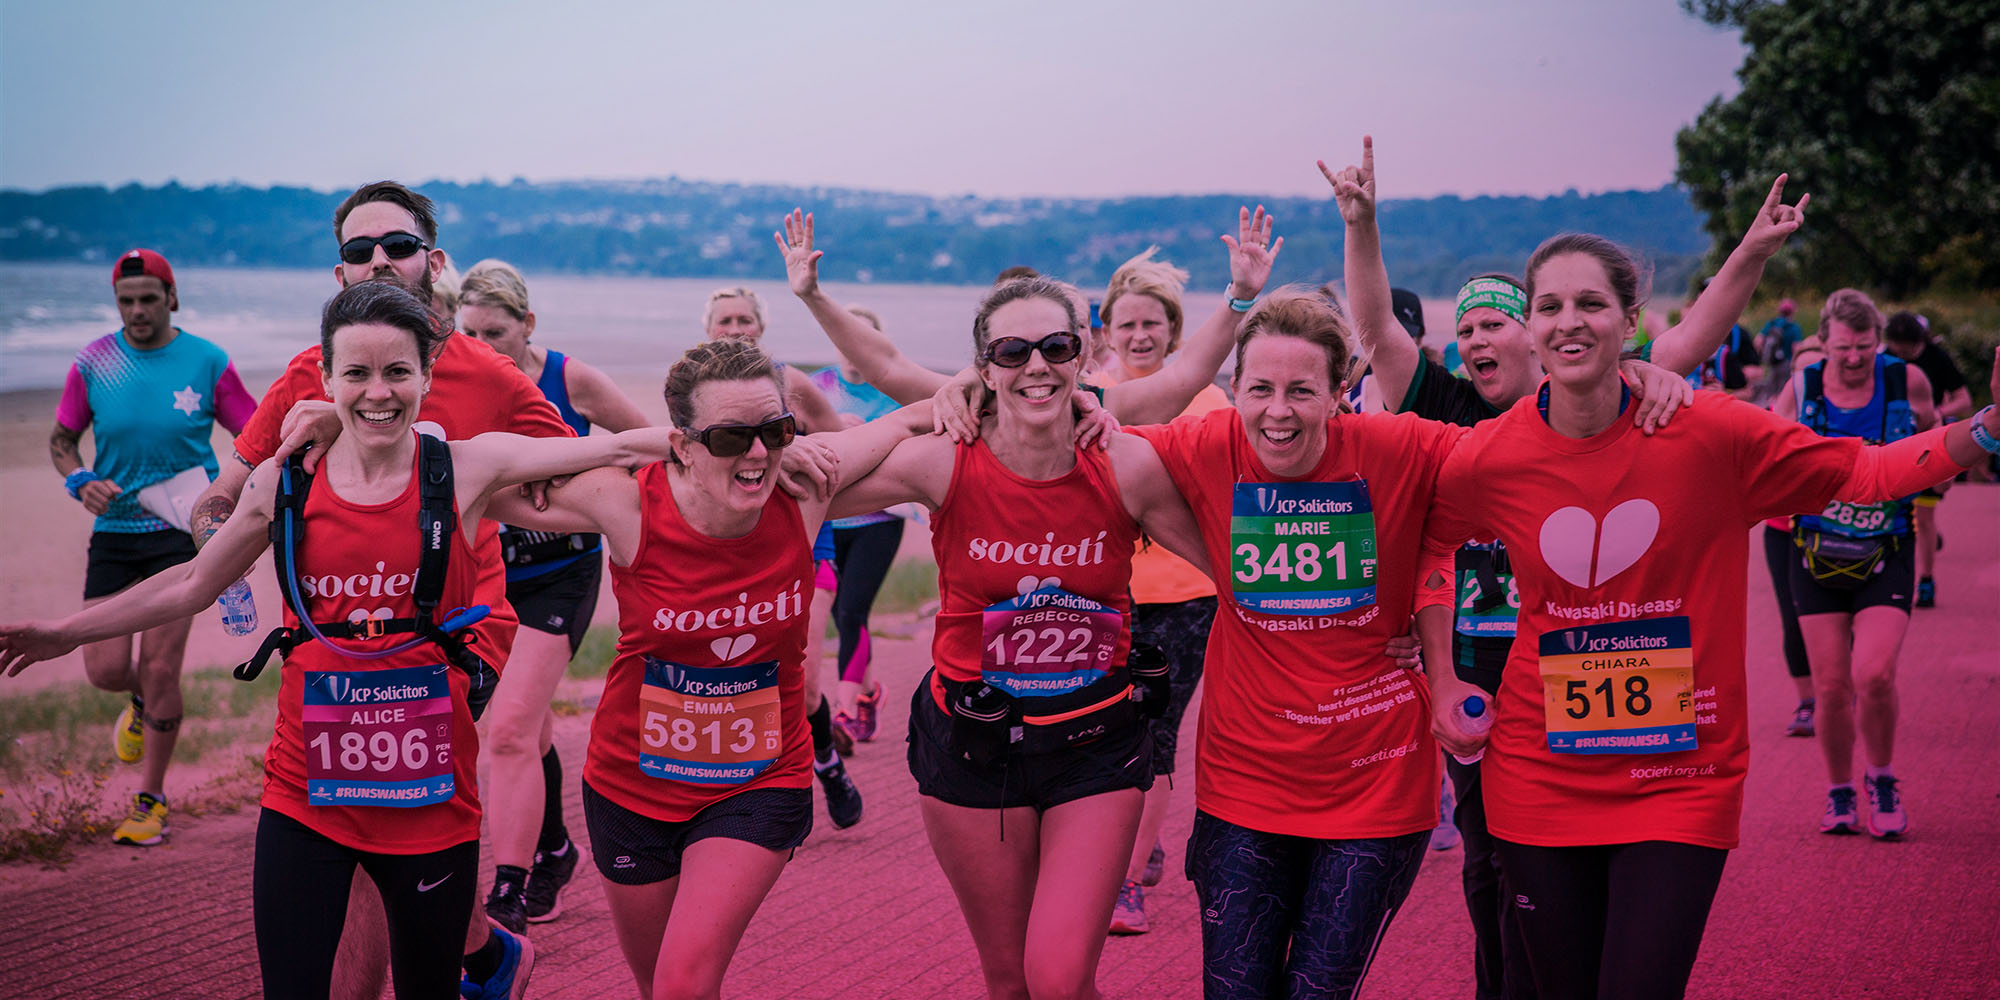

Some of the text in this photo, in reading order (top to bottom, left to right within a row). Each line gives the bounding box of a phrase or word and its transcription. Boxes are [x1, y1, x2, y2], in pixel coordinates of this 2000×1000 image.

[1276, 498, 1354, 515] JCP Solicitors
[1822, 499, 1884, 530] 2859
[431, 521, 441, 551] OMM
[1274, 521, 1331, 536] MARIE
[1234, 541, 1347, 583] 3481
[1360, 558, 1377, 567] PEN
[1363, 566, 1374, 579] E
[1462, 576, 1522, 609] 28
[1030, 593, 1102, 611] JCP Solicitors
[1260, 596, 1352, 610] #RUNSWANSEA
[1618, 597, 1683, 619] Disease
[1012, 611, 1093, 627] REBECCA
[987, 628, 1093, 666] 1222
[1588, 635, 1668, 652] JCP Solicitors
[1097, 650, 1109, 662] C
[1581, 656, 1651, 672] CHIARA
[350, 682, 429, 704] JCP Solicitors
[683, 678, 758, 697] JCP Solicitors
[1317, 679, 1411, 713] heart disease in children
[1361, 699, 1395, 716] change
[1395, 690, 1417, 704] that
[1565, 675, 1653, 720] 518
[683, 700, 736, 715] EMMA
[350, 707, 406, 726] ALICE
[642, 710, 757, 755] 5813
[1574, 733, 1670, 748] #RUNSWANSEA
[309, 727, 430, 773] 1896
[435, 742, 450, 752] PEN
[765, 737, 778, 750] D
[437, 751, 450, 765] C
[664, 763, 755, 778] #RUNSWANSEA
[1629, 763, 1718, 780] societi.org.uk
[335, 786, 429, 800] #RUNSWANSEA
